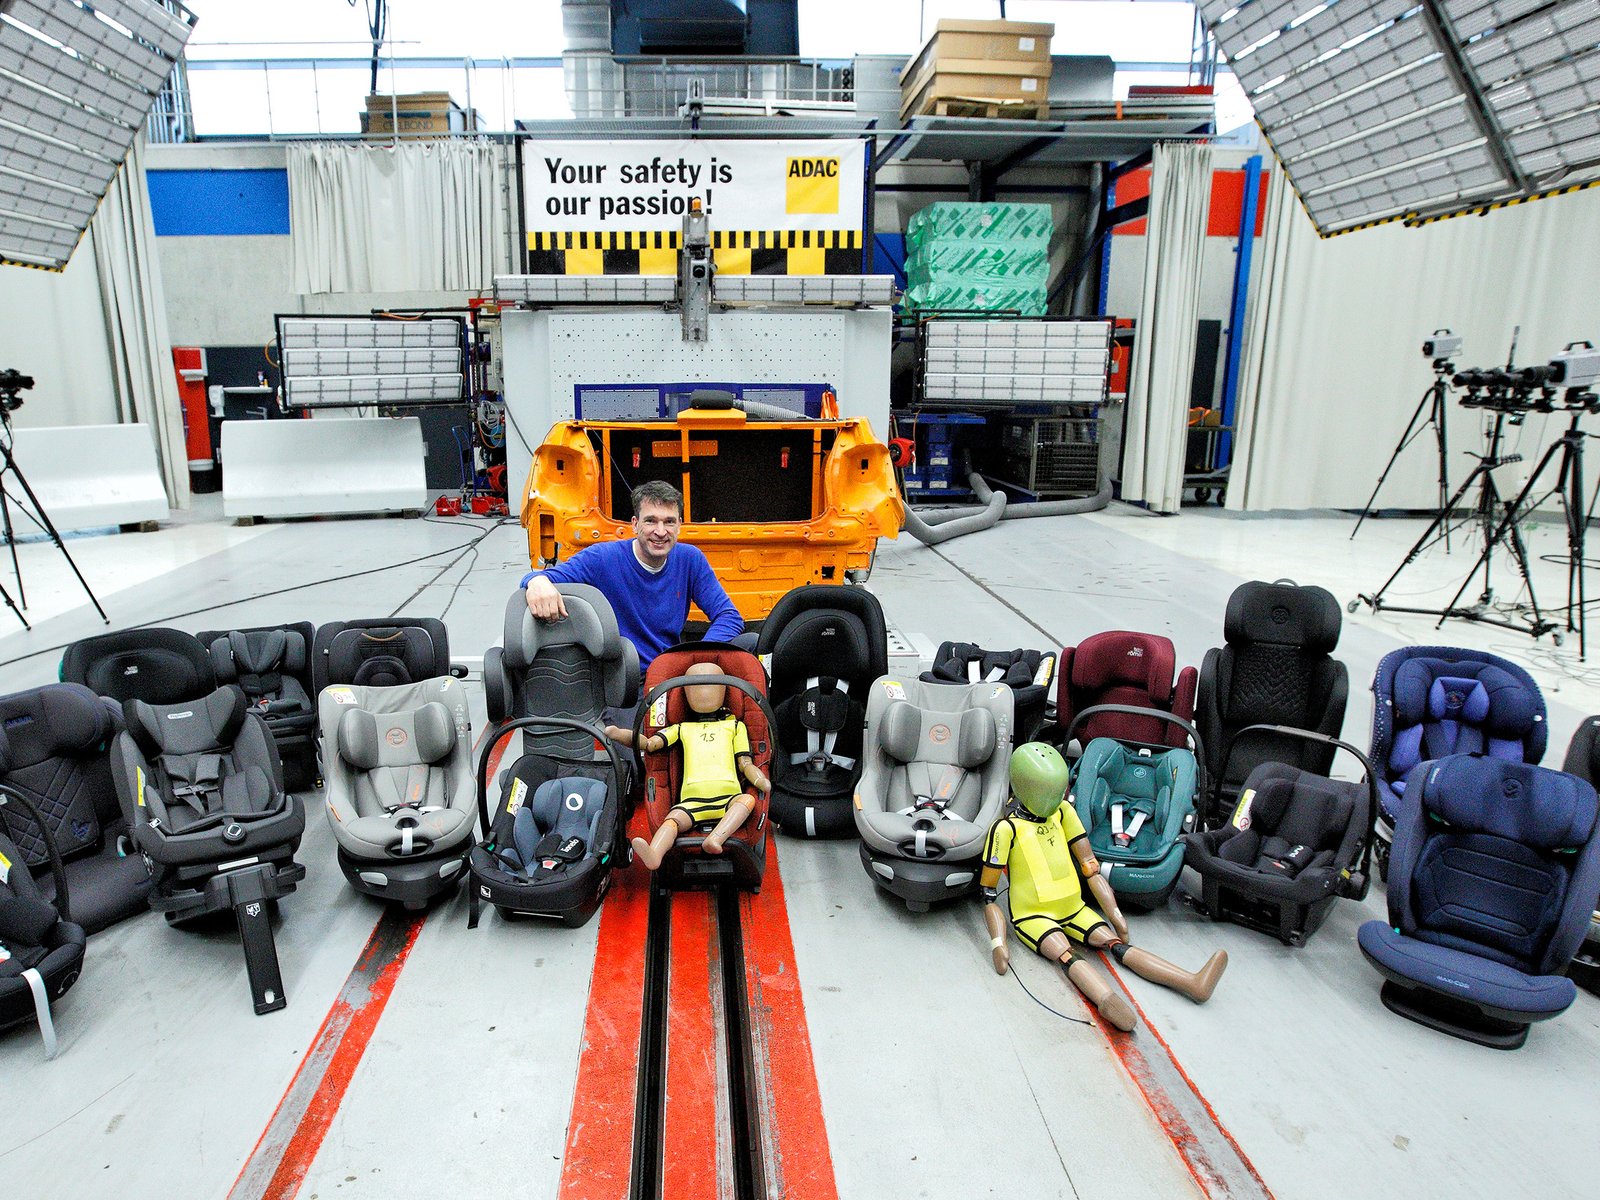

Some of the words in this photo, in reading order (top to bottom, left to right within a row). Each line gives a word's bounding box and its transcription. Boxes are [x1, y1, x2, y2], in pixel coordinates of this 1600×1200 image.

[544, 157, 607, 184] Your
[619, 156, 701, 188] safety
[710, 156, 733, 183] is
[788, 159, 838, 178] ADAC
[545, 196, 591, 216] our
[700, 732, 716, 743] 1.5
